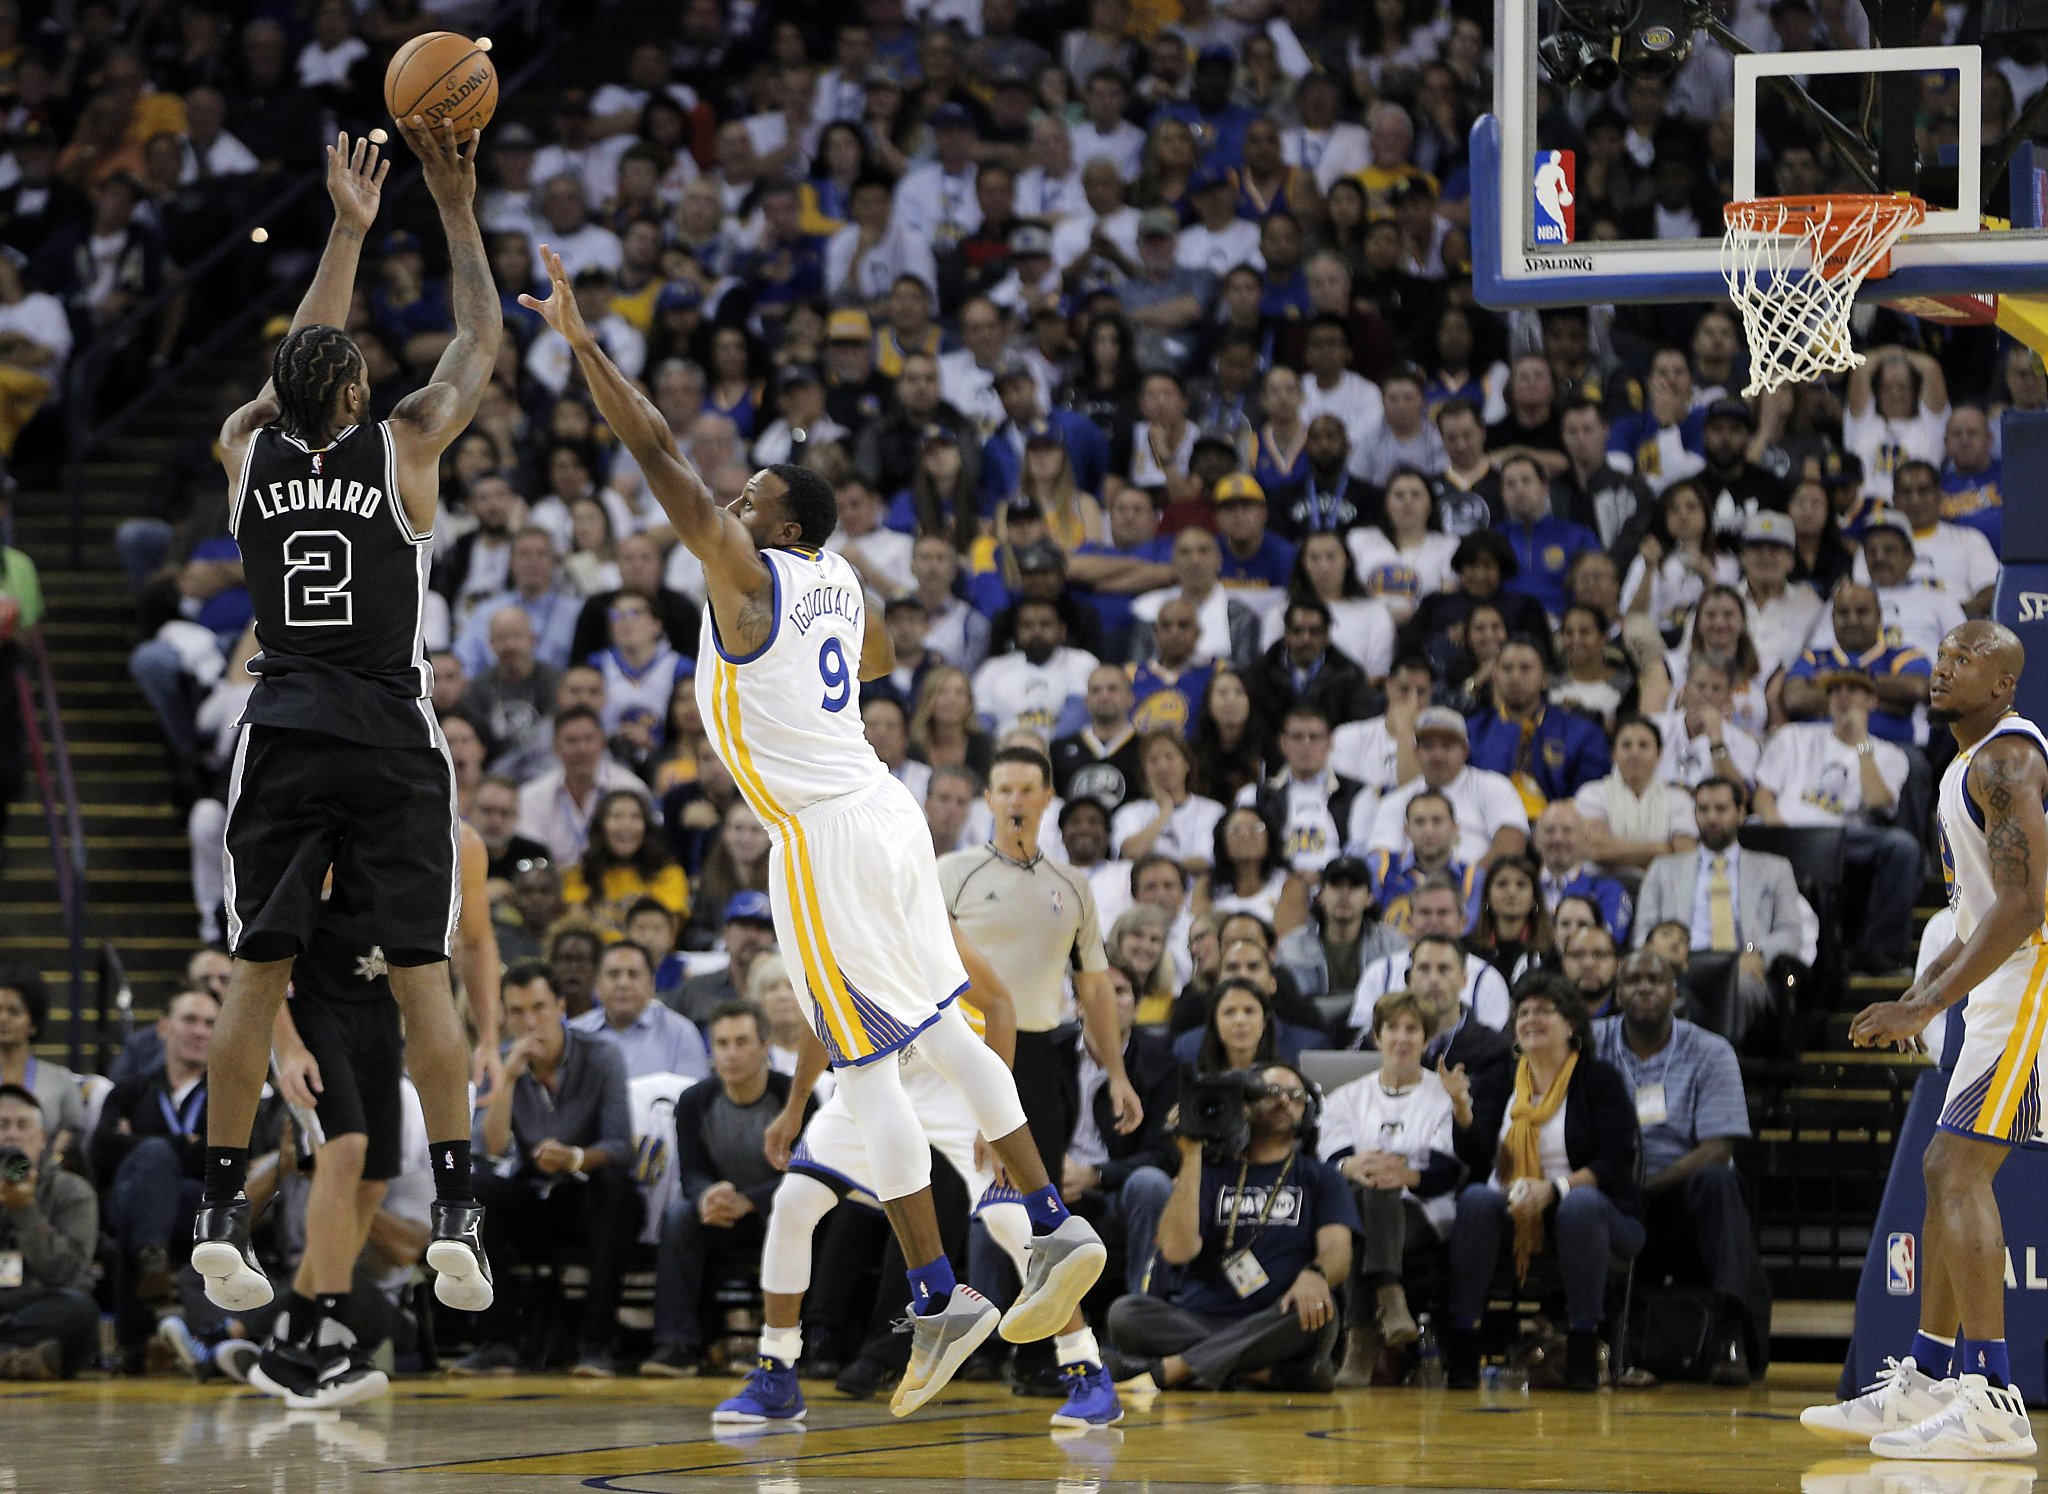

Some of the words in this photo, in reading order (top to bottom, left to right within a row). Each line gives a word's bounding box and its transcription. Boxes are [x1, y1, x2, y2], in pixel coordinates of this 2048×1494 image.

[1537, 224, 1561, 240] NBA
[1525, 256, 1593, 273] SPALDING
[254, 478, 383, 520] LEONARD
[283, 530, 353, 626] 2
[789, 586, 860, 637] IGUODALA
[818, 637, 851, 713] 9
